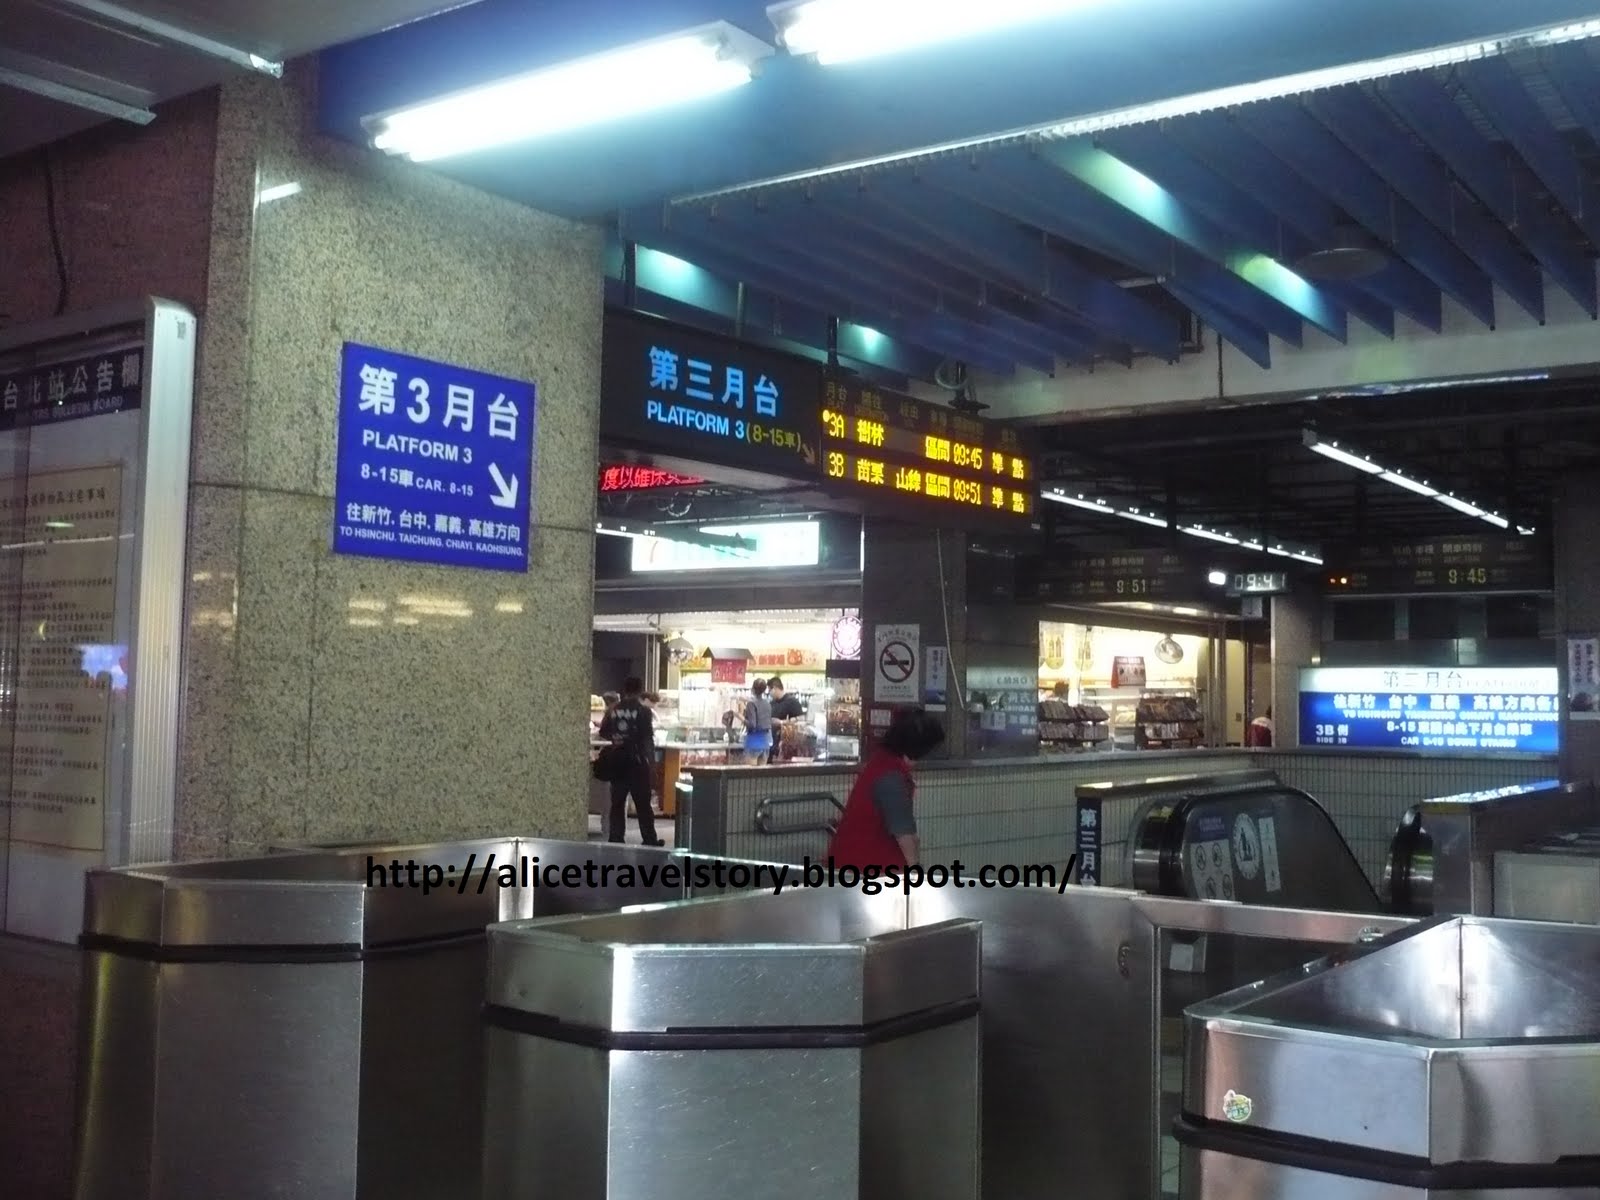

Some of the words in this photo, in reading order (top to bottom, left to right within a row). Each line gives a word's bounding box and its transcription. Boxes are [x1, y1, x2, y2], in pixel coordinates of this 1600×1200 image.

[648, 346, 779, 417] 第三月台
[358, 363, 519, 441] 第3月台
[647, 400, 729, 436] PLATFORM
[735, 420, 745, 439] 3
[362, 429, 458, 462] PLATFORM
[463, 447, 473, 464] 3
[449, 482, 474, 497] 8-15
[340, 525, 352, 537] TO
[355, 528, 396, 542] HSINCHU.
[1316, 724, 1334, 735] 3B
[1401, 737, 1419, 745] CAR
